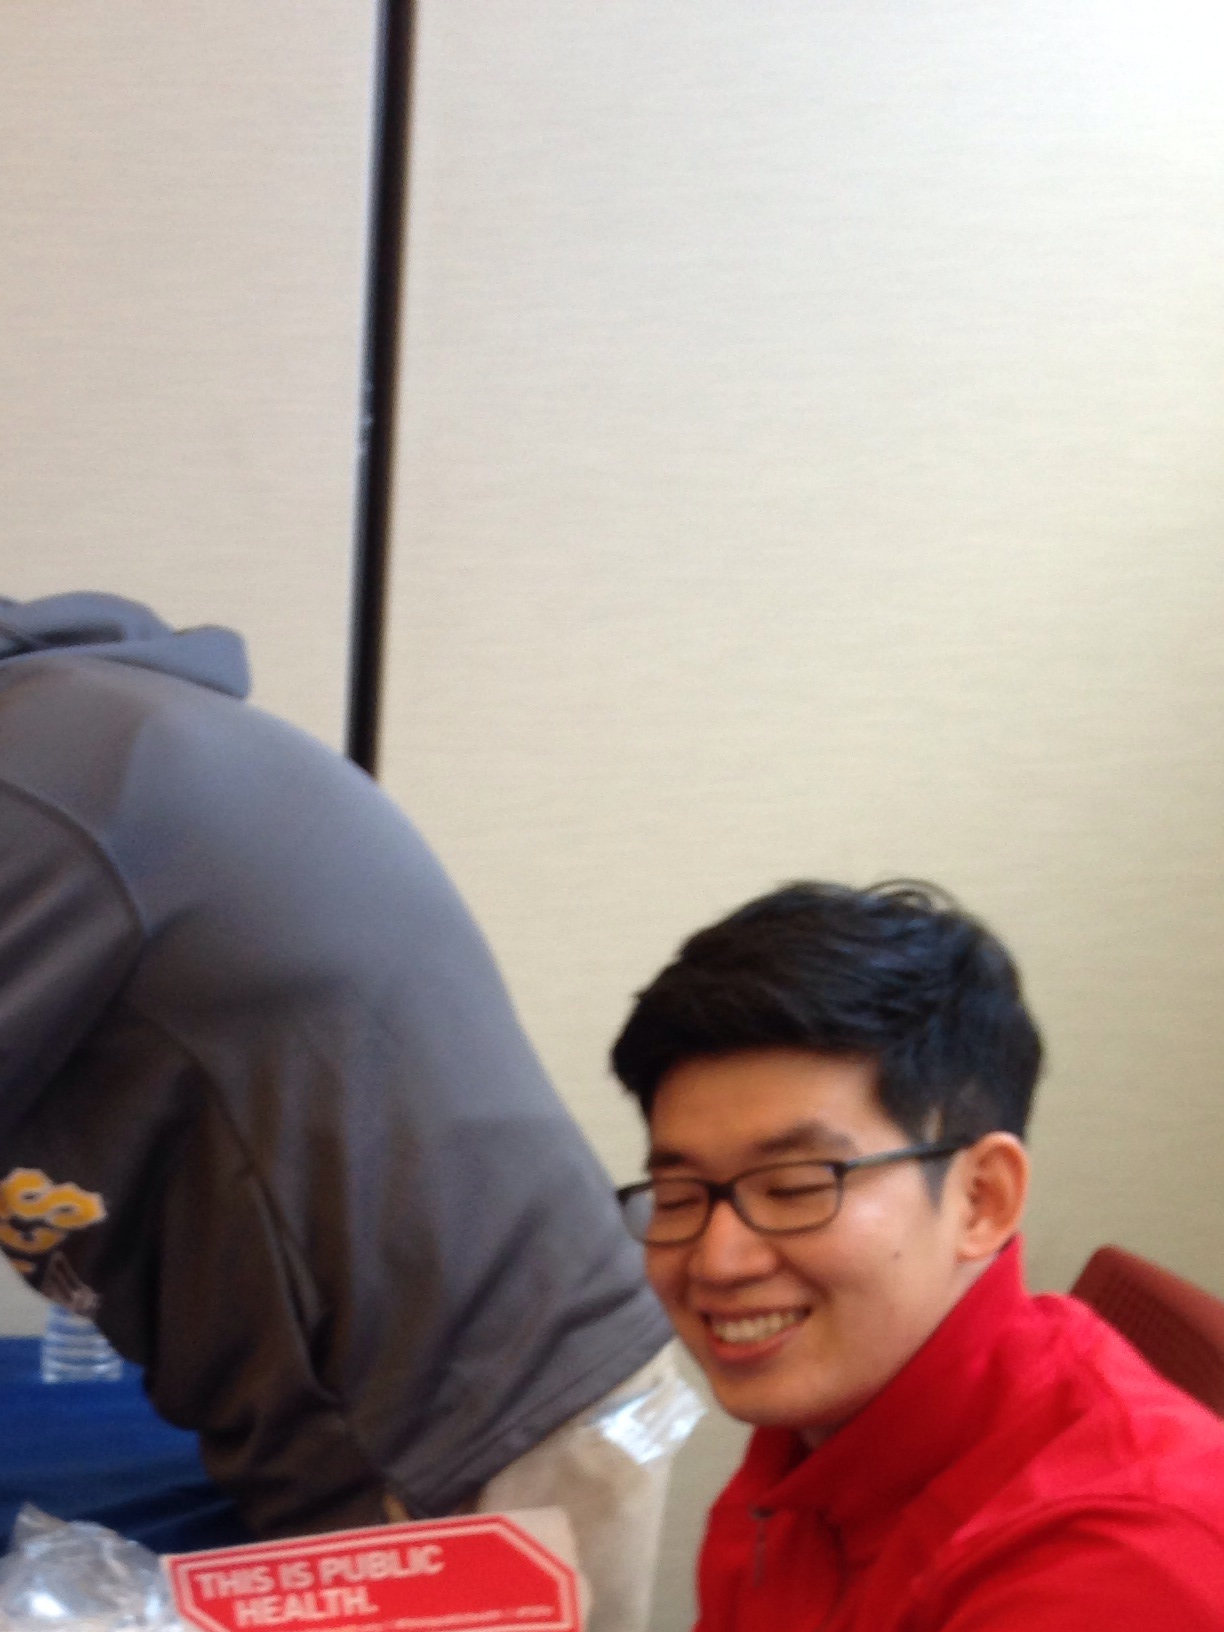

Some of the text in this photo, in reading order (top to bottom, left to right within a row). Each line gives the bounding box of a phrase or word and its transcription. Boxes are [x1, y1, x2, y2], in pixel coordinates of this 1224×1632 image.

[195, 1544, 445, 1601] THIS IS PUBLIC
